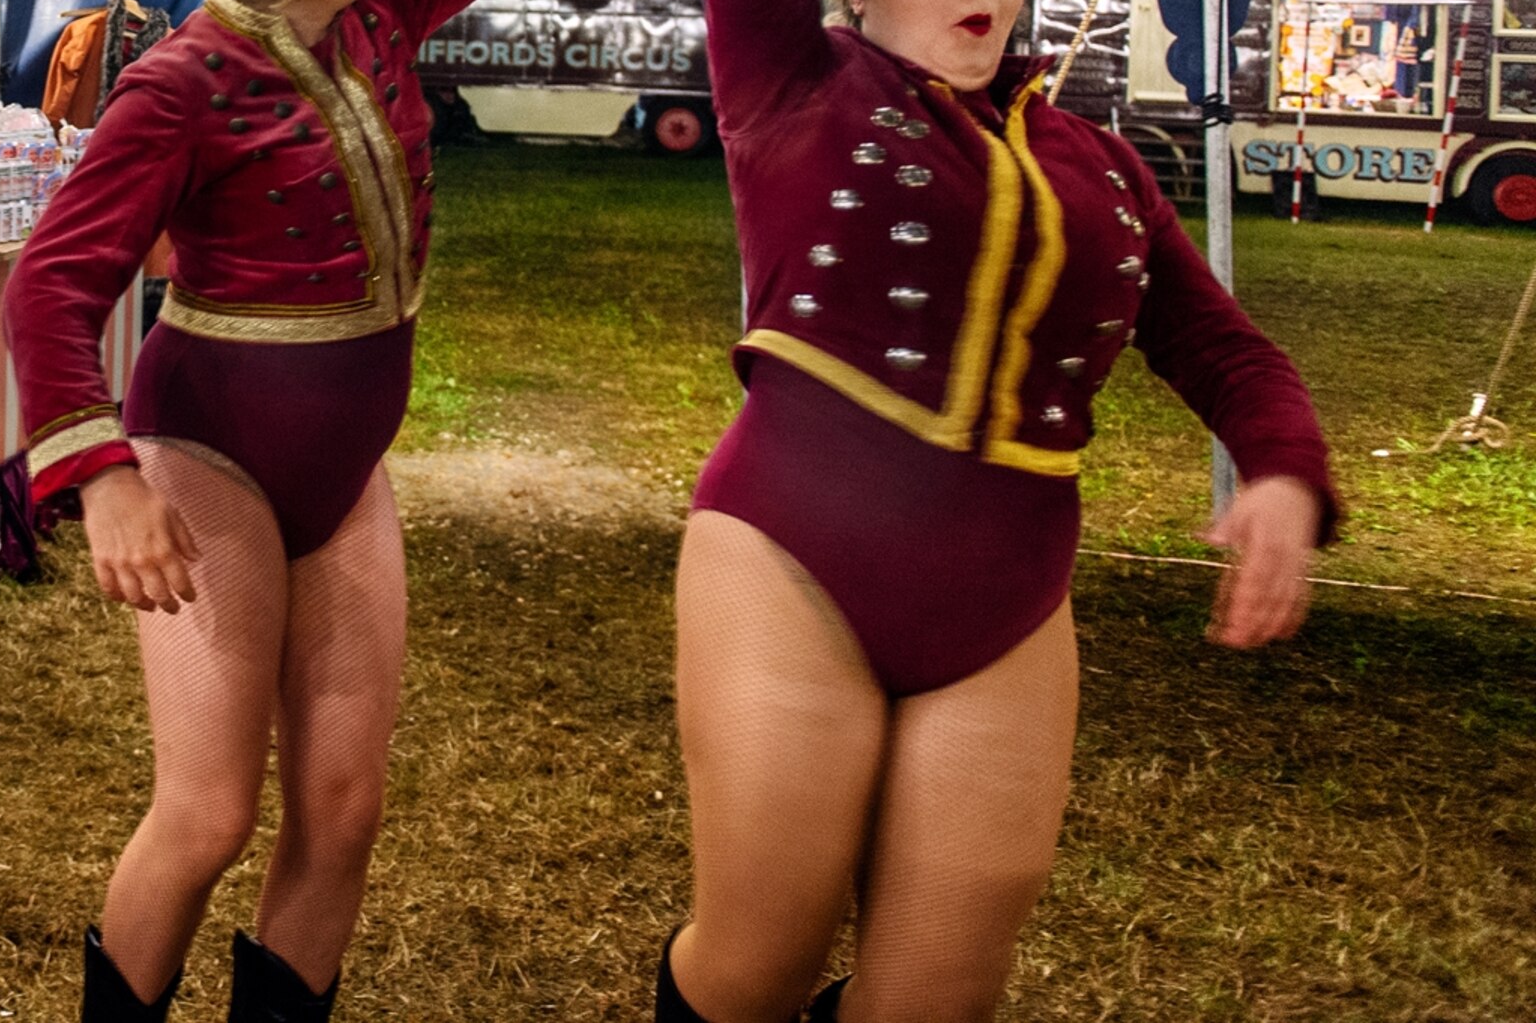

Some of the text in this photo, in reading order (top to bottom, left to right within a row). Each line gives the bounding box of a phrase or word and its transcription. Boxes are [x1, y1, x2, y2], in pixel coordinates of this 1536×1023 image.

[418, 39, 692, 72] IFFORDS CIRCUS
[1243, 138, 1436, 183] STORE
